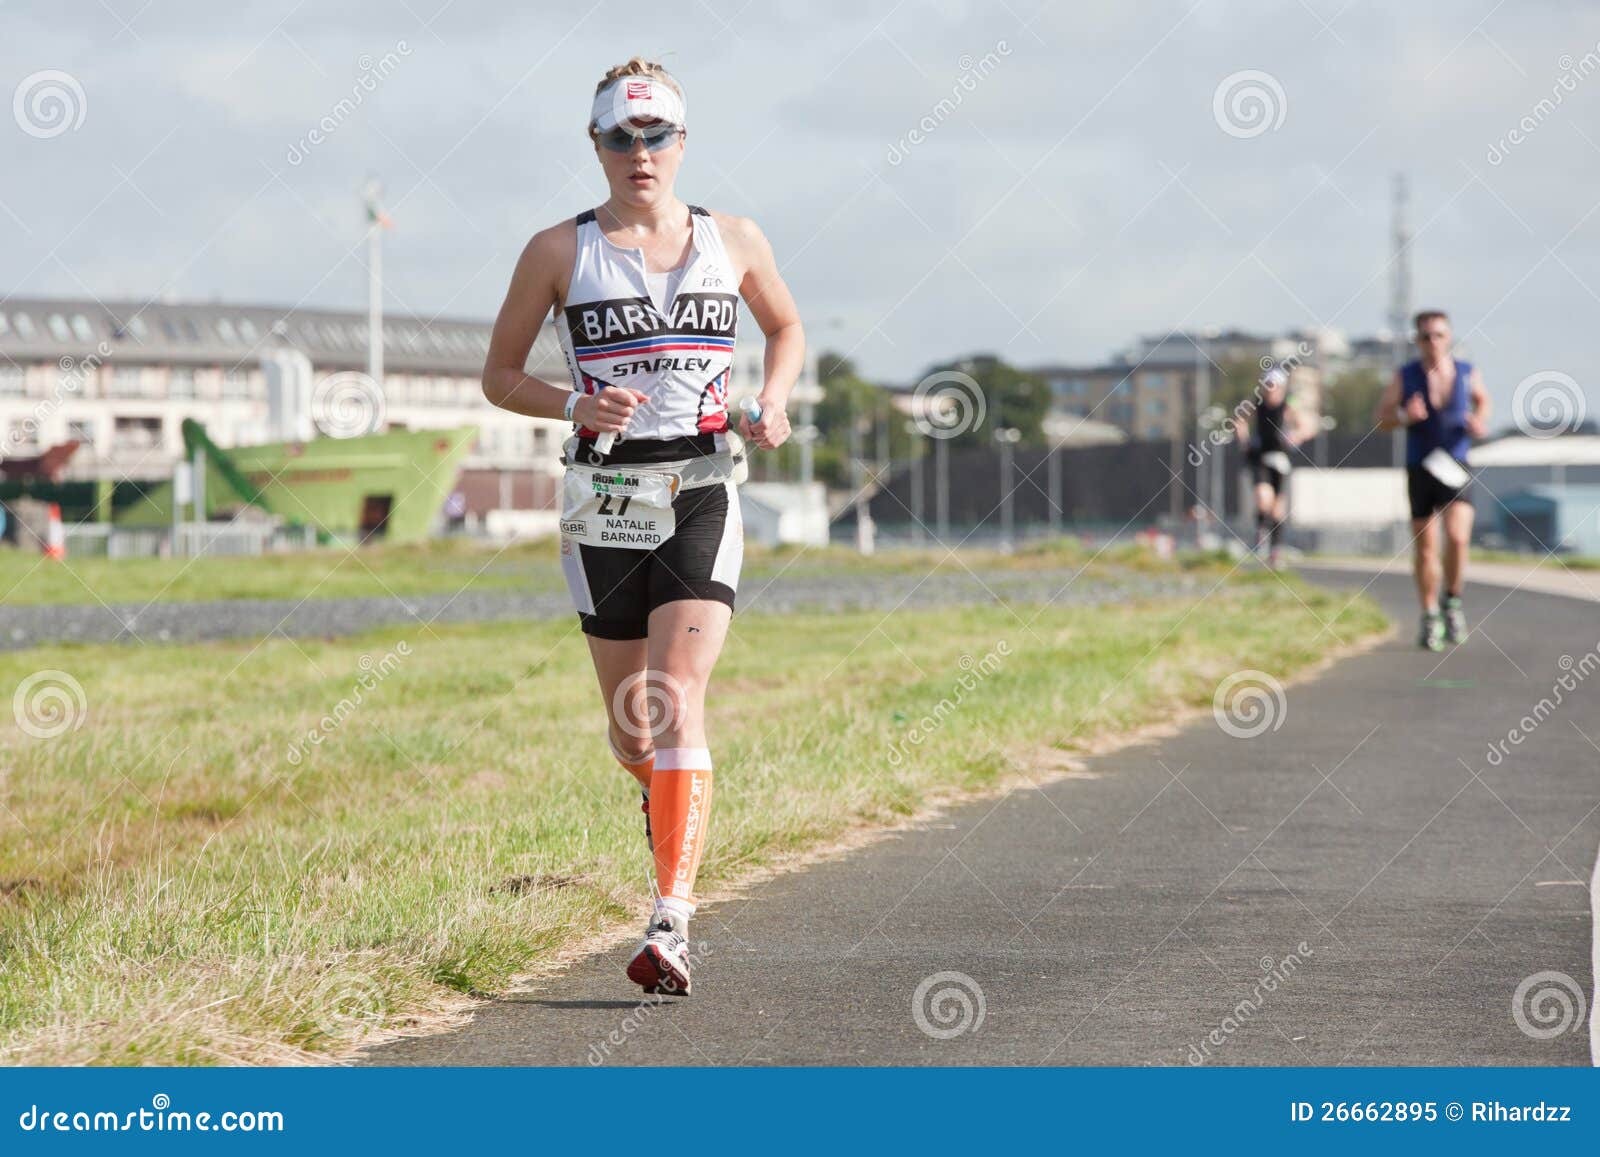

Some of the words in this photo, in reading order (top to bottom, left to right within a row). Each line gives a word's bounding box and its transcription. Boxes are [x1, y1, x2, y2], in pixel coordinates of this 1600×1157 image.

[582, 300, 734, 341] BARNARD
[591, 472, 640, 487] IRONMAN
[597, 492, 632, 517] 27
[562, 523, 586, 533] GBR
[606, 519, 656, 531] NATALIE
[601, 531, 661, 545] BARNARD
